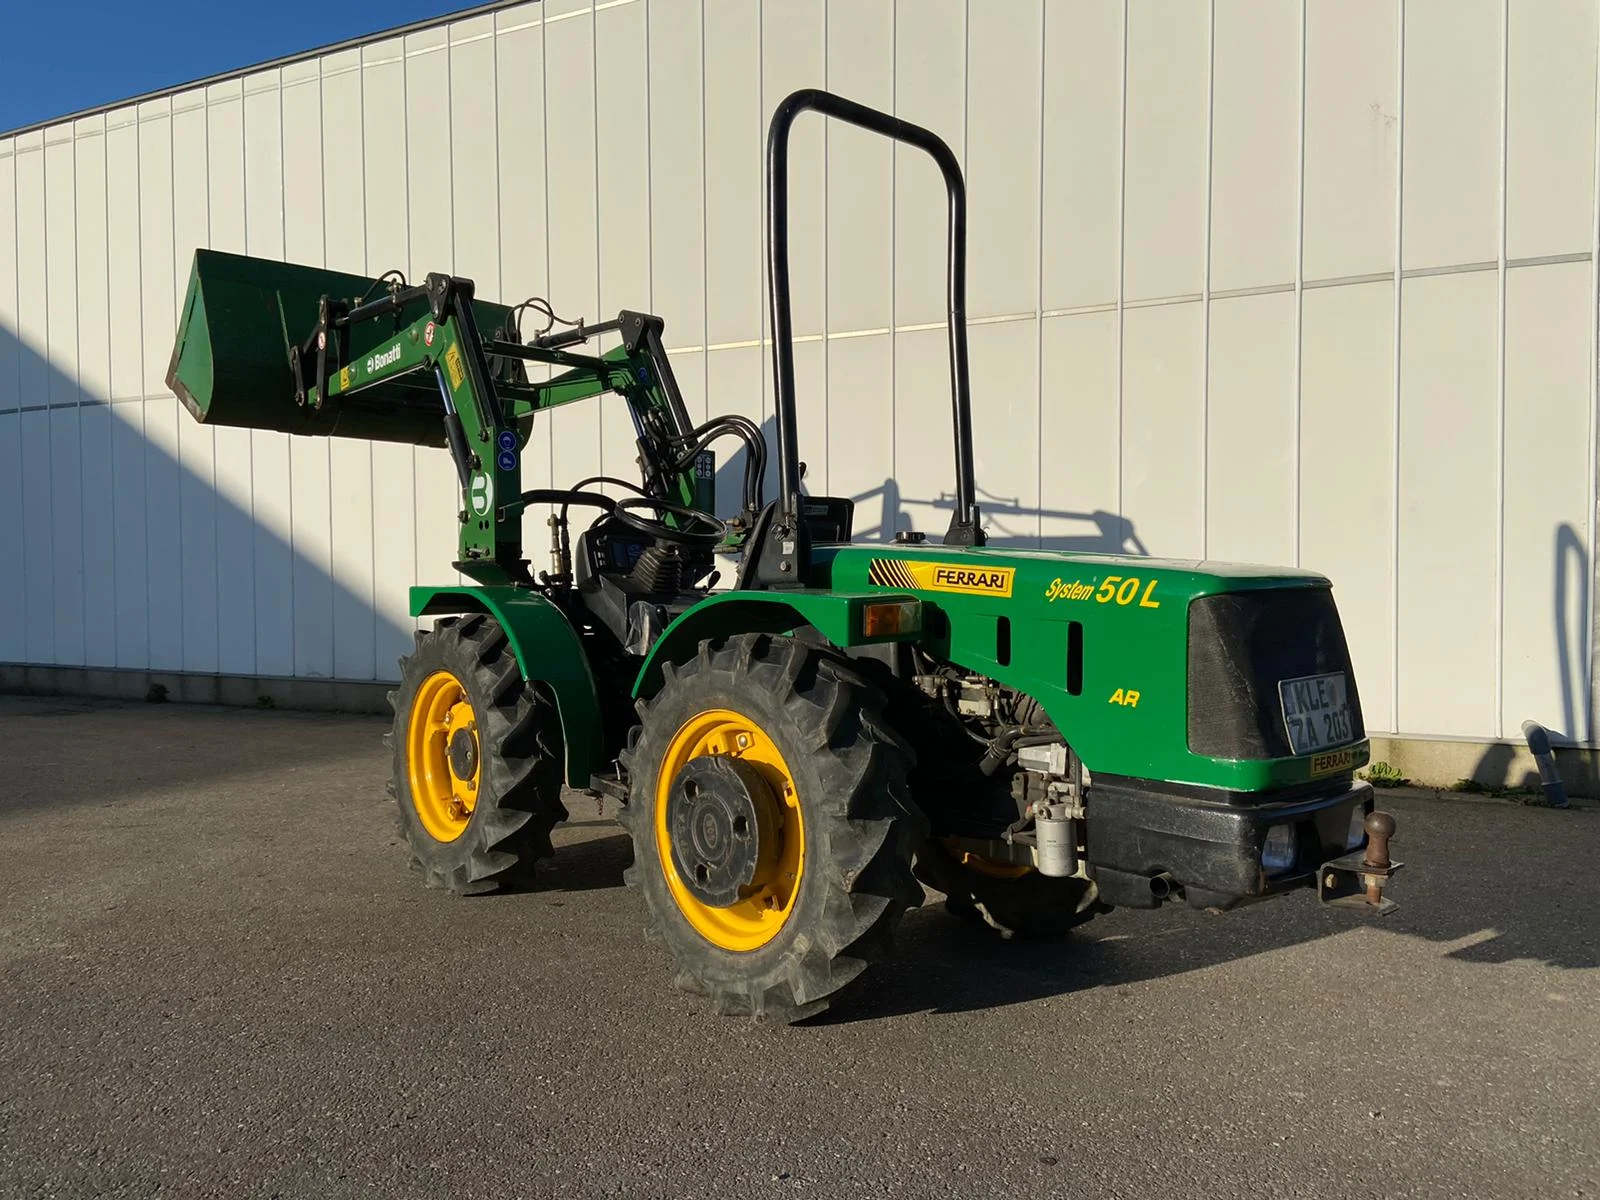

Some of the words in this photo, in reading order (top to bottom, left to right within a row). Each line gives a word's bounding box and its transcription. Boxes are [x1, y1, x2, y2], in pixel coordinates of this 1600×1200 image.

[374, 342, 401, 371] Bonatti
[935, 569, 1006, 590] FERRARI
[1045, 577, 1095, 602] System
[1108, 687, 1141, 708] AR
[1293, 679, 1330, 715] KLE
[1313, 751, 1351, 772] FERRARI
